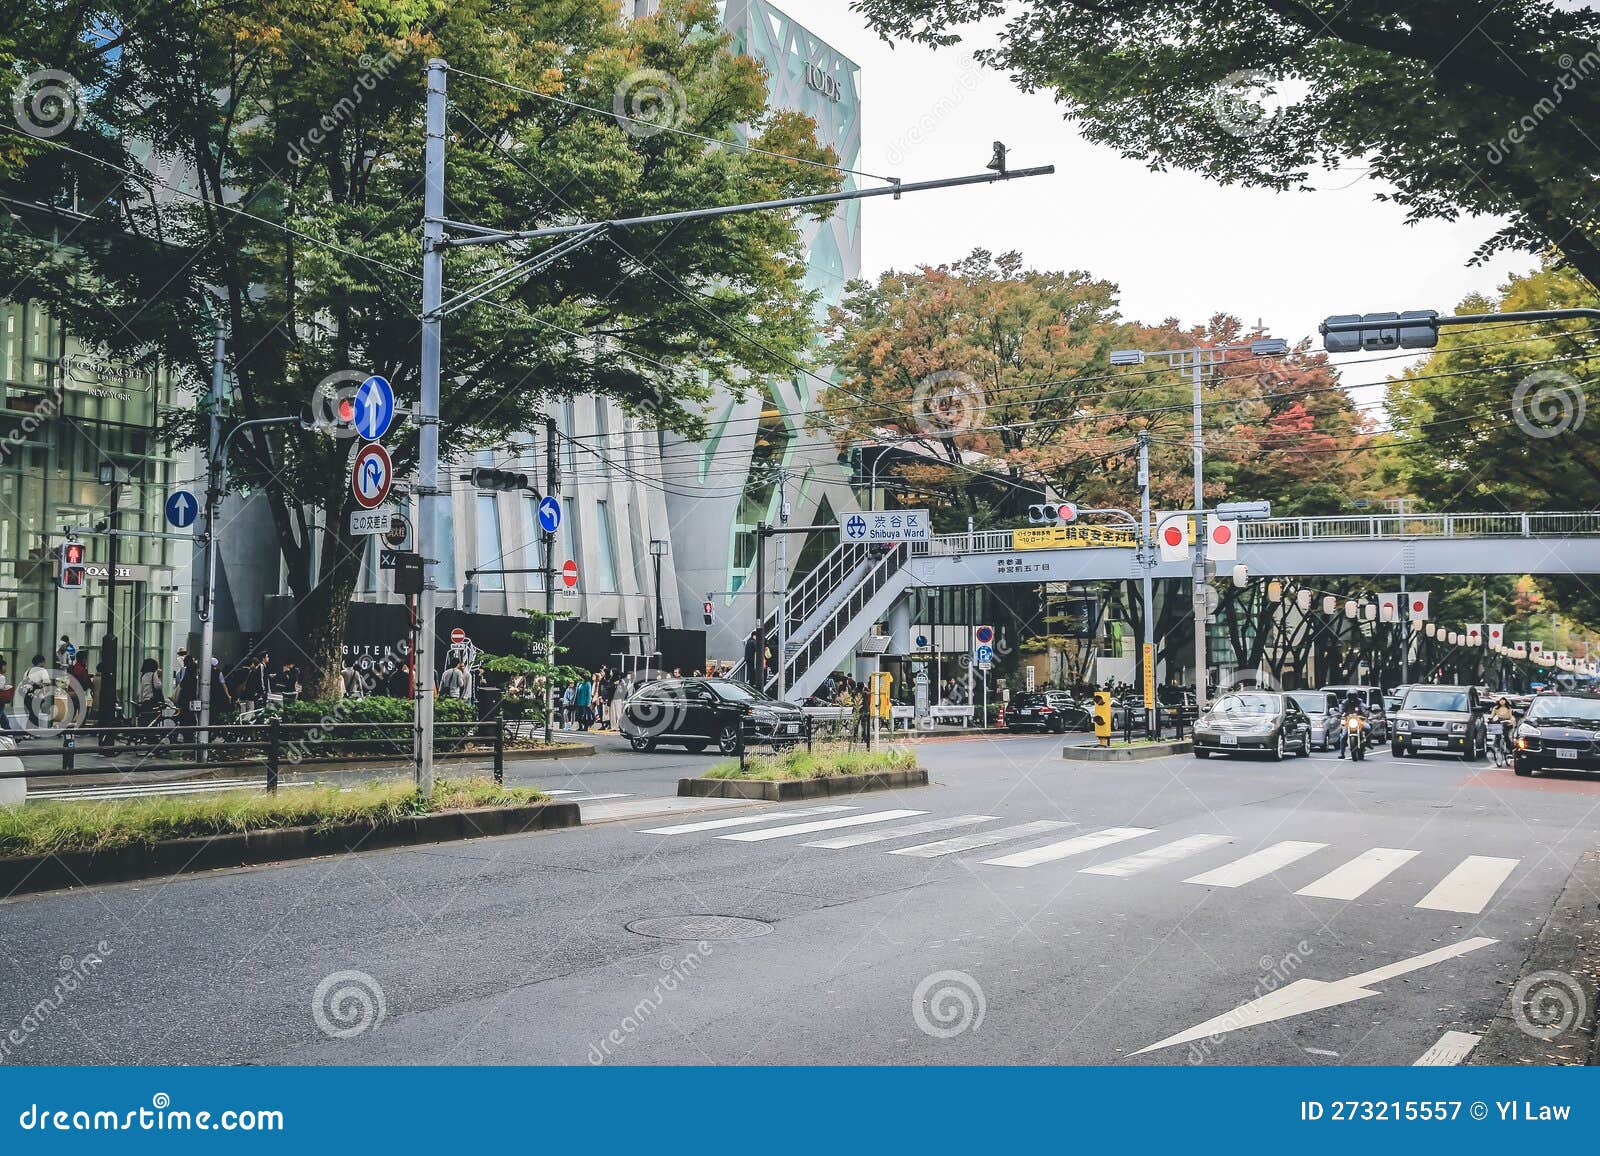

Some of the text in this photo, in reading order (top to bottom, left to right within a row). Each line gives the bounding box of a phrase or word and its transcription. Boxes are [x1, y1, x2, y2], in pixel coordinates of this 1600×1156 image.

[76, 361, 143, 380] COACH
[109, 391, 132, 401] YORK
[353, 515, 388, 530] この交差点
[875, 515, 919, 528] 渋谷区
[870, 529, 925, 539] Shibuya Ward
[82, 566, 131, 577] OAH
[342, 645, 392, 656] GUTEN
